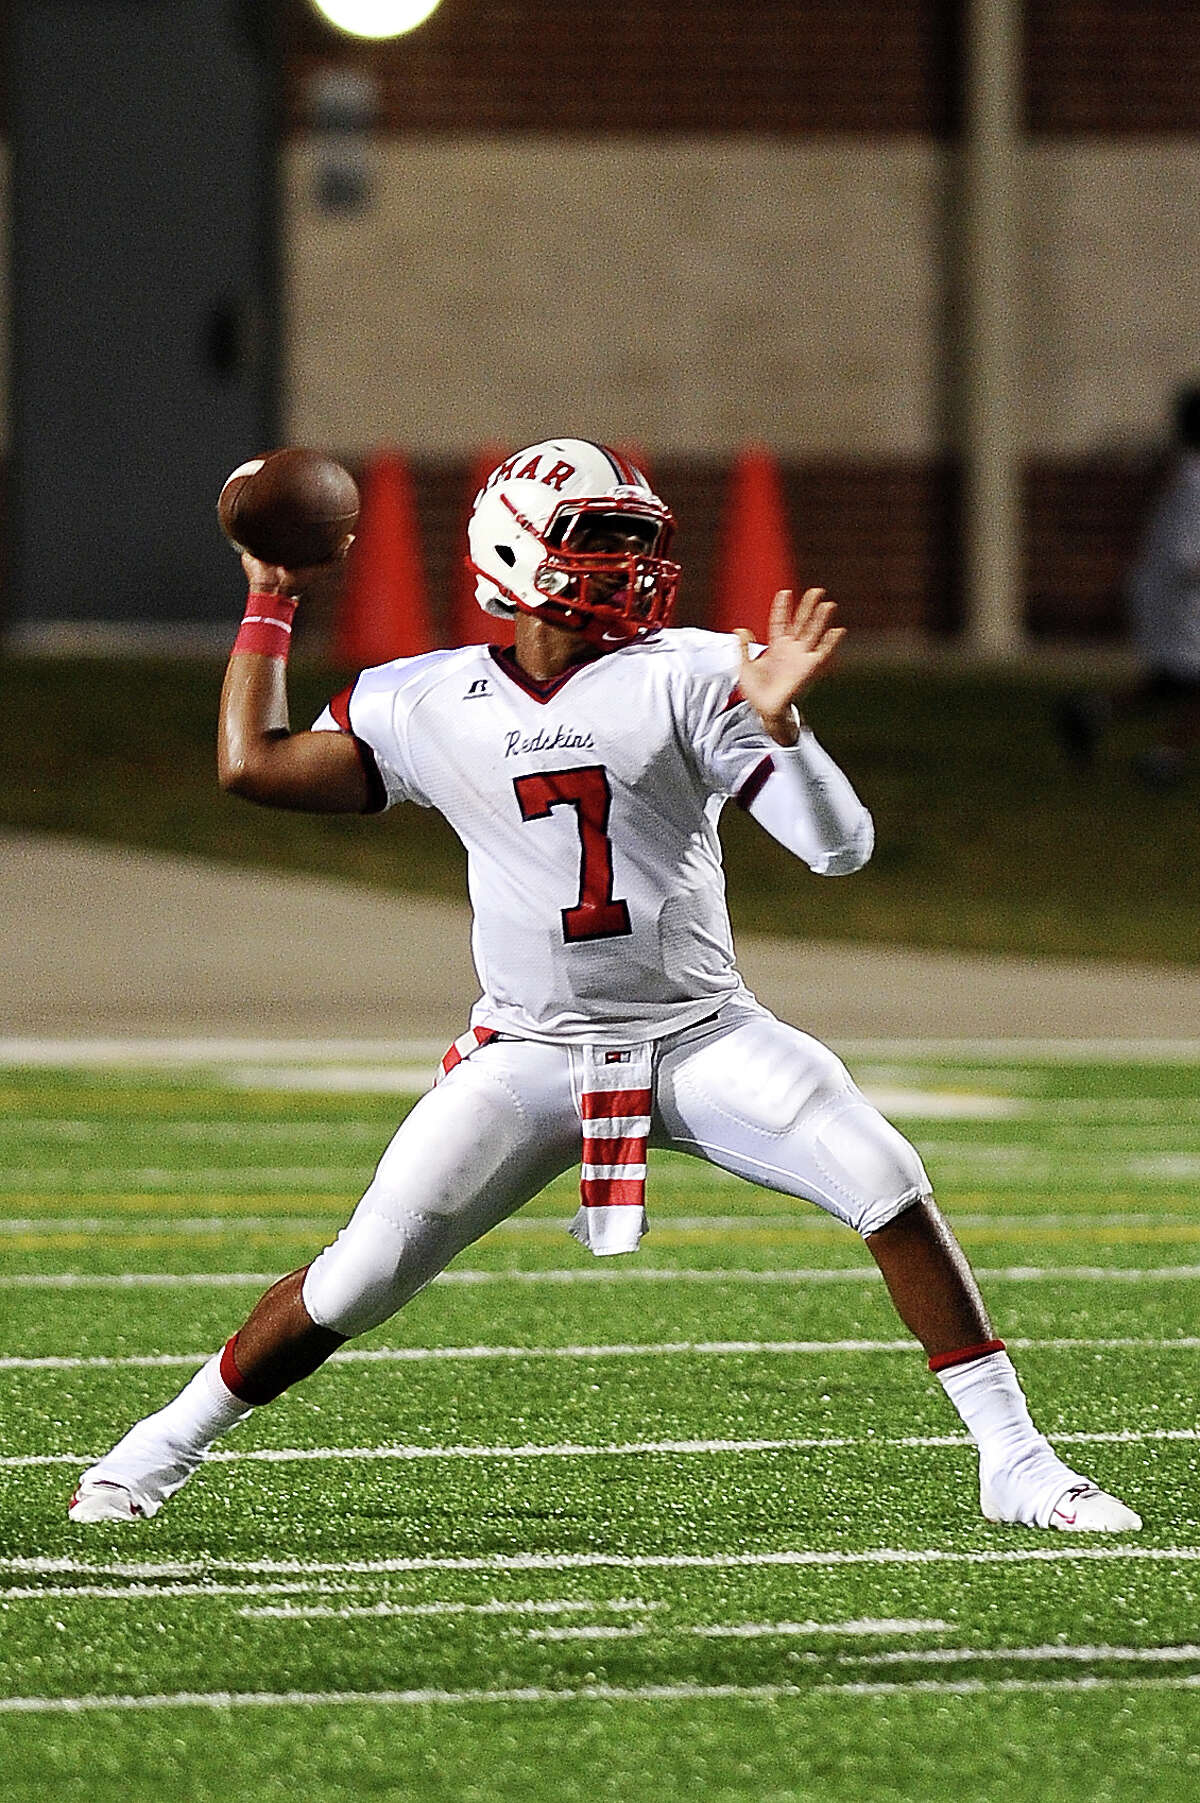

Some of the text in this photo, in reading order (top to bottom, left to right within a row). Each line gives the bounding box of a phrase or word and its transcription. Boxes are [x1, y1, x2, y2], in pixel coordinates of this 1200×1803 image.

[481, 454, 576, 497] MAR
[504, 724, 595, 758] Redskins
[512, 765, 633, 944] 7
